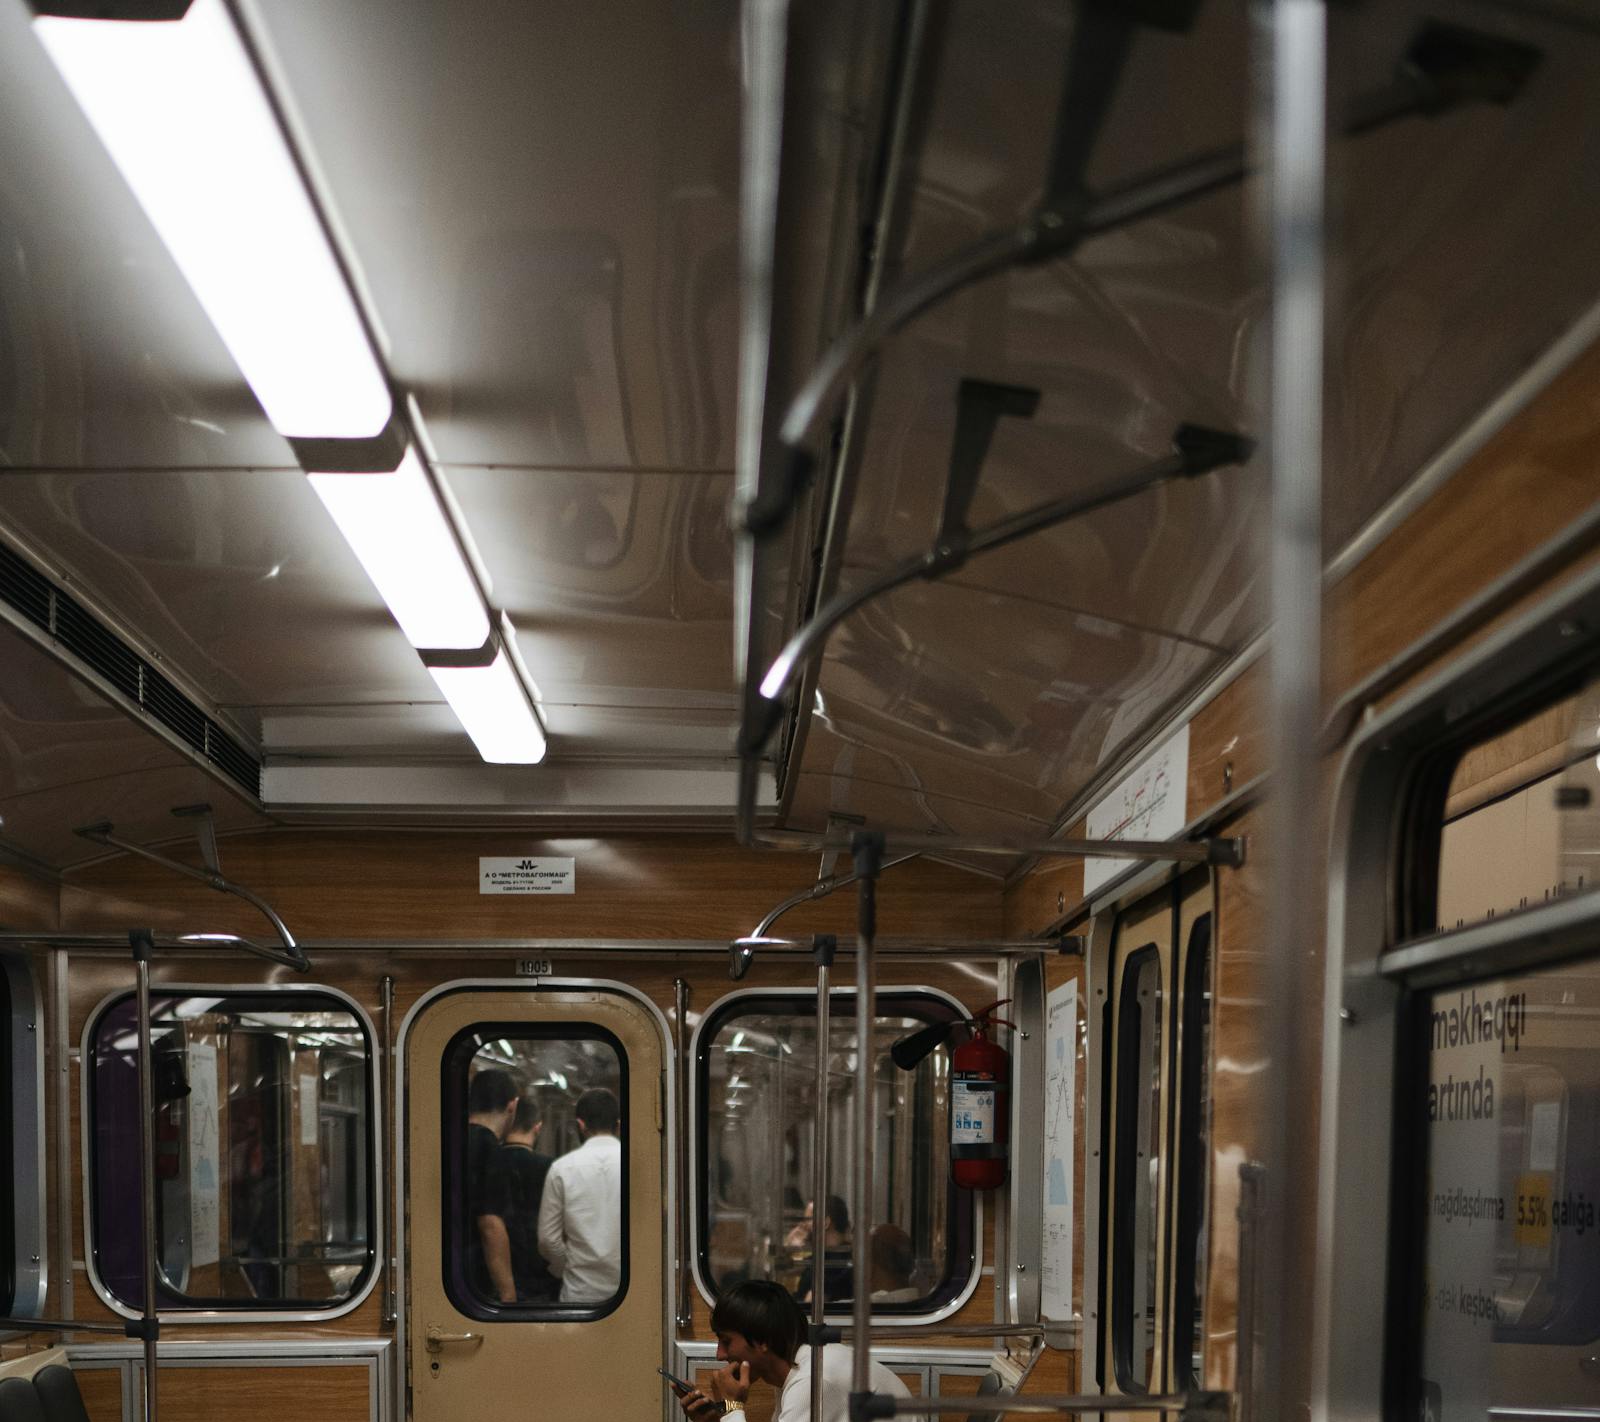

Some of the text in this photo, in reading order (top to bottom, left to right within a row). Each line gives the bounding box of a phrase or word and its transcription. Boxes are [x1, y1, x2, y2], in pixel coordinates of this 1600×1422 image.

[521, 960, 548, 973] 1905
[1518, 1195, 1546, 1227] 5.5%
[1552, 1192, 1594, 1235] qalığa
